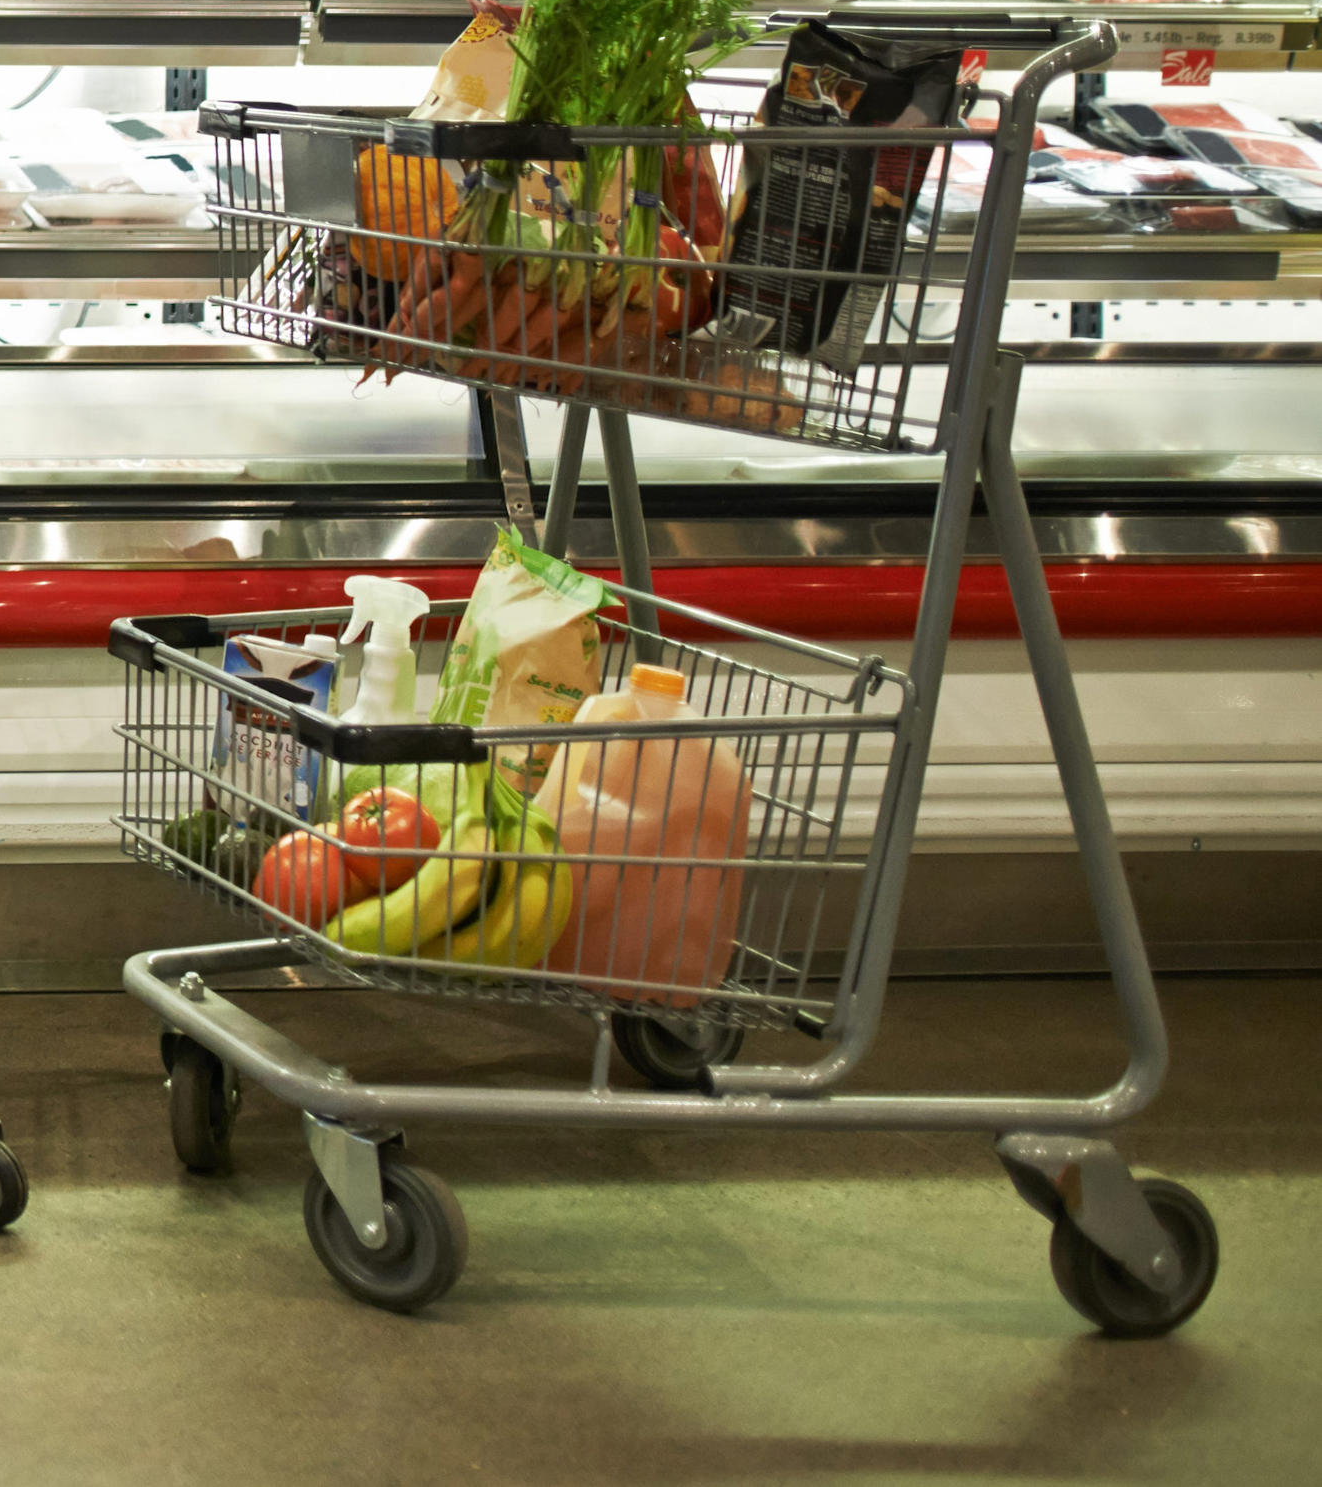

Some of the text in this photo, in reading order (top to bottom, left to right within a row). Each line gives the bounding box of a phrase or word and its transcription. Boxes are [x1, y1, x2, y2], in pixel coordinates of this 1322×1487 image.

[1161, 50, 1214, 84] Sale
[526, 673, 584, 701] Sea Salt
[228, 743, 302, 767] EERAGE
